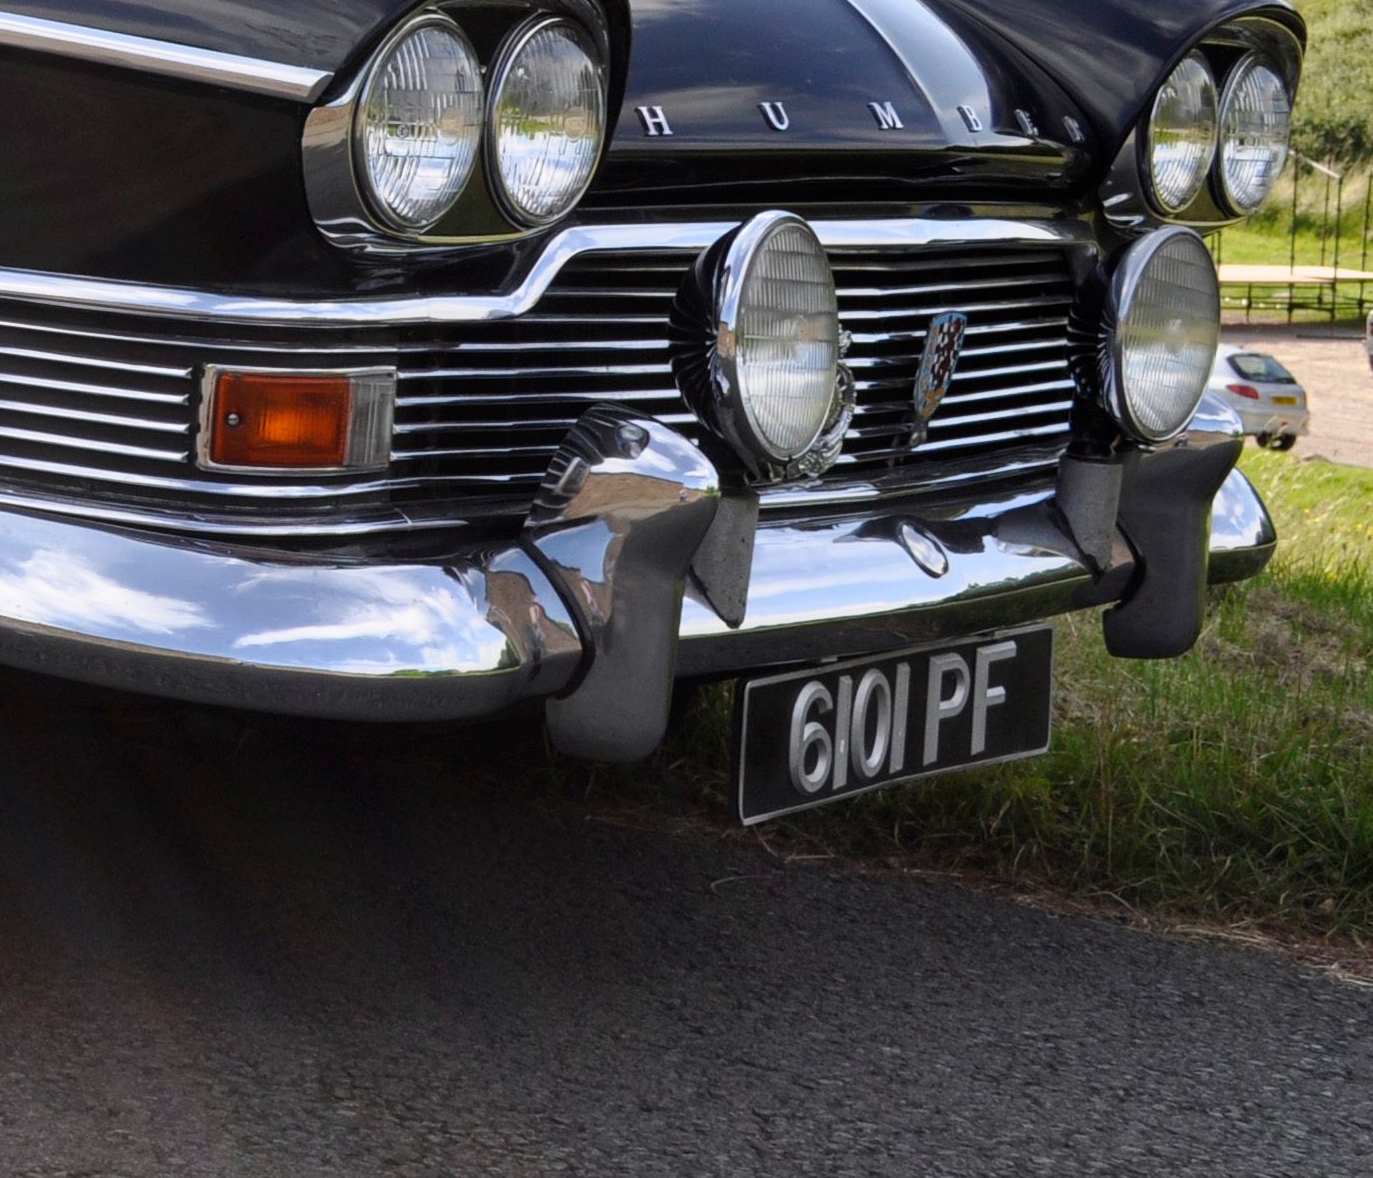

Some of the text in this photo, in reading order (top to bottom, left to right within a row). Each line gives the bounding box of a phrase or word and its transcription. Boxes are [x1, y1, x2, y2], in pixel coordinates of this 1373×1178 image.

[633, 100, 1086, 144] HUMBER
[789, 640, 1017, 793] 6101 PF
